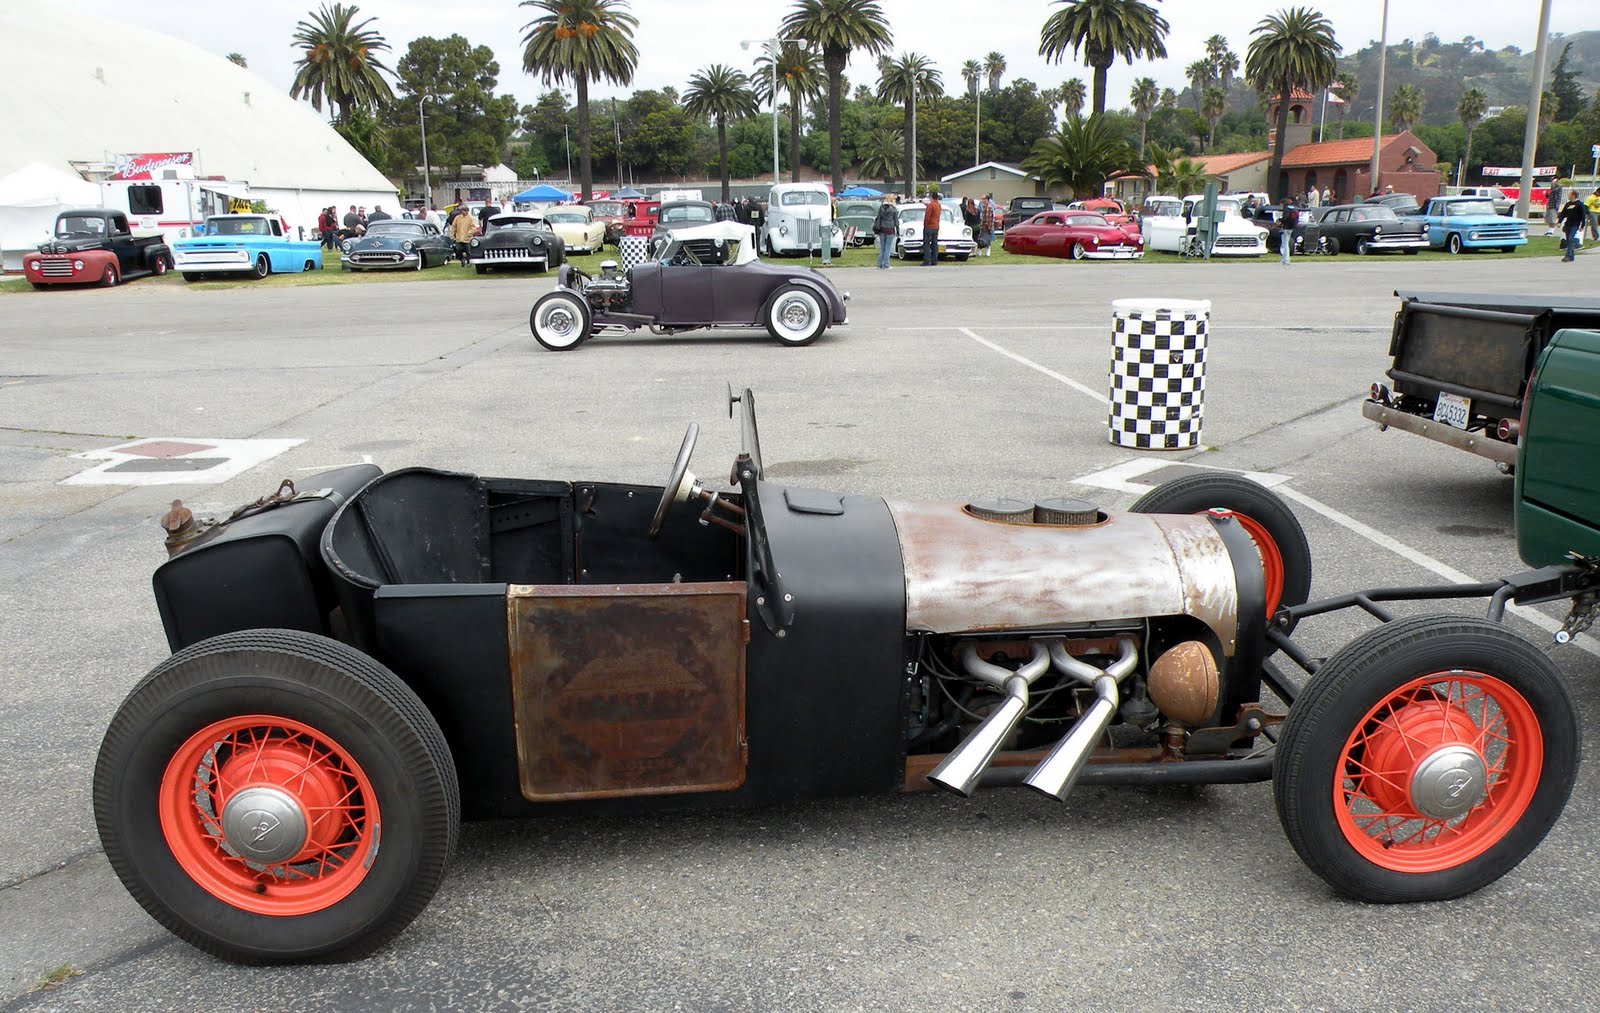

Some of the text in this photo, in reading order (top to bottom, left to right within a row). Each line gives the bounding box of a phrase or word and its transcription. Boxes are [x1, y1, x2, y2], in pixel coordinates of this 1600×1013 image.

[119, 153, 190, 178] Budweiser
[1483, 167, 1501, 176] EXIT
[1539, 167, 1556, 176] EXIT
